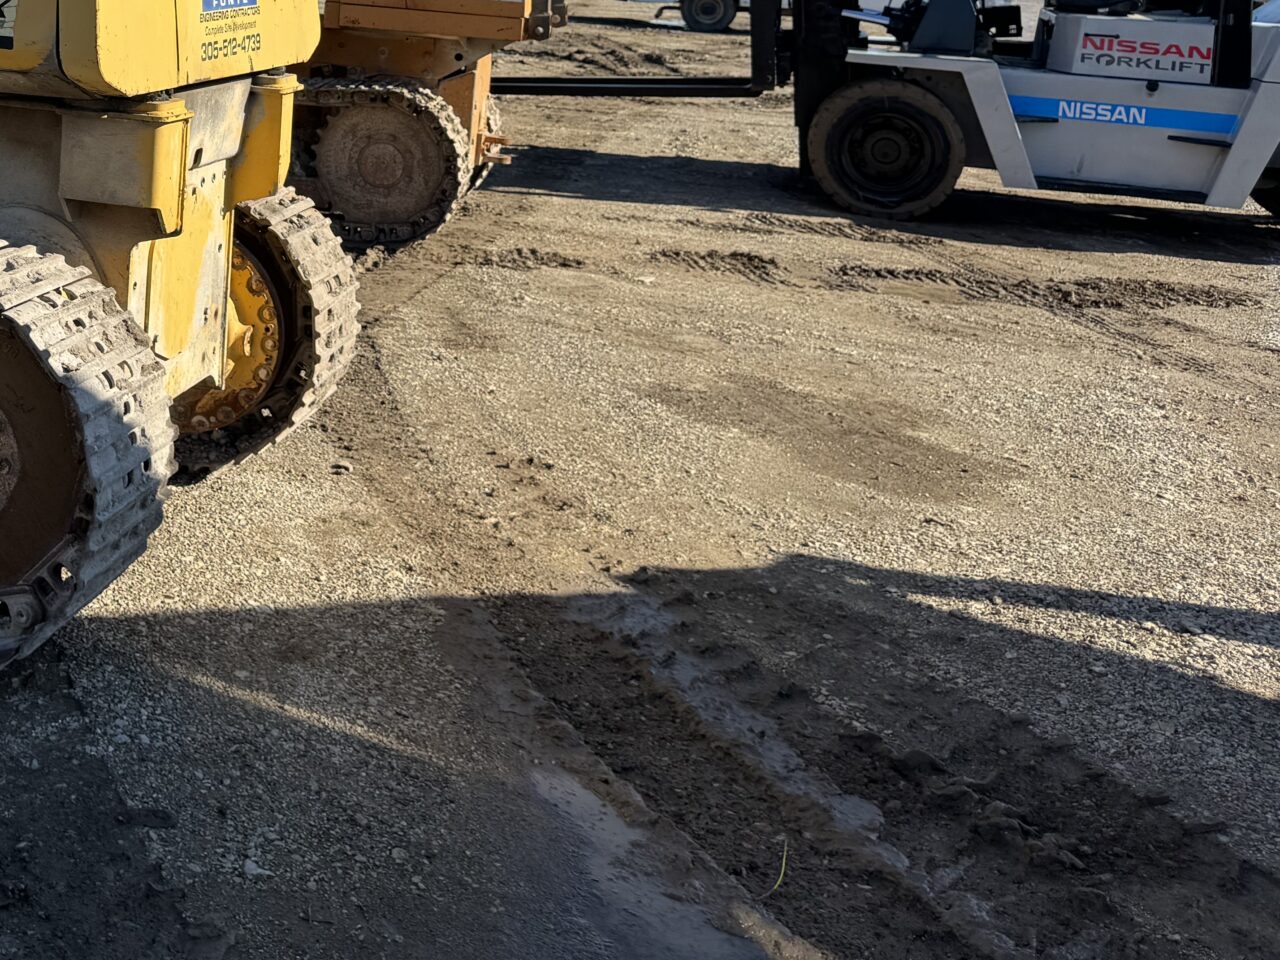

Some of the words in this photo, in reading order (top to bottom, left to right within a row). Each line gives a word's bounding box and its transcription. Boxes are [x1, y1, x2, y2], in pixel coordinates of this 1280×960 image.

[200, 10, 228, 23] ENGINEERING
[230, 6, 261, 19] CONTRACTORS
[201, 33, 261, 61] 305-512-4739
[1082, 36, 1212, 60] NISSAN
[1080, 53, 1210, 74] FORKLIFT
[1058, 101, 1146, 125] NISSAN
